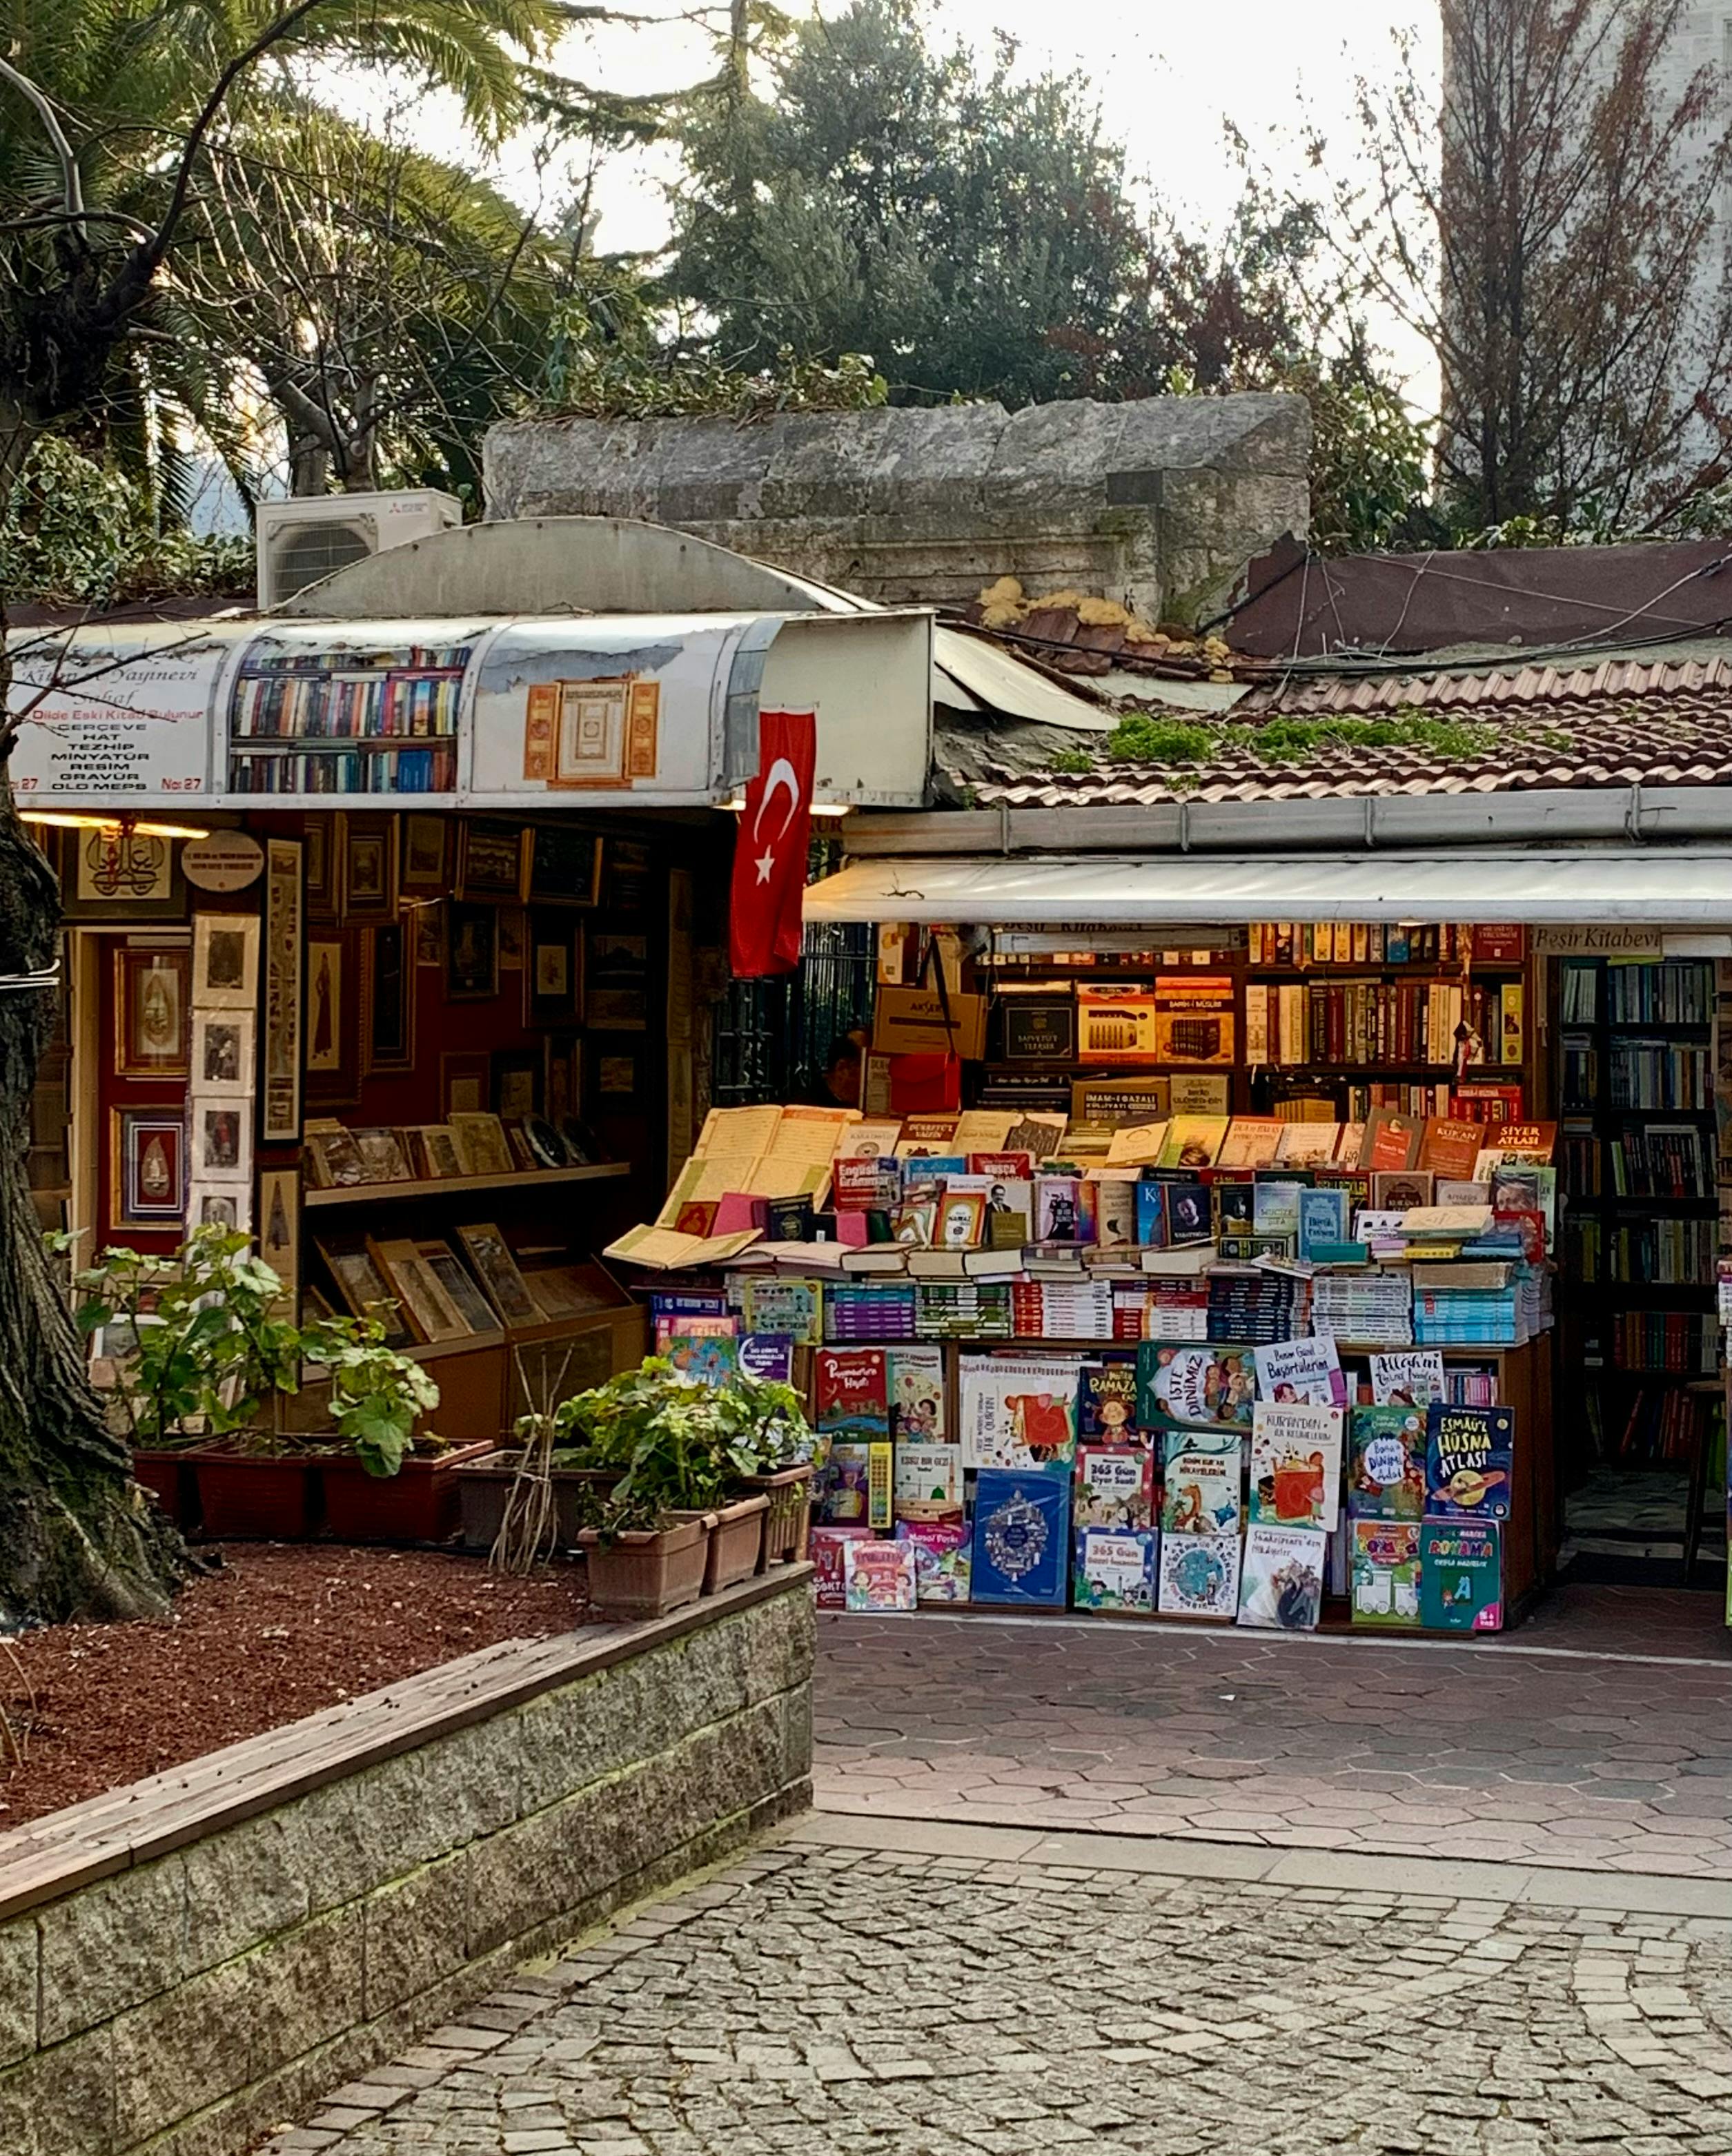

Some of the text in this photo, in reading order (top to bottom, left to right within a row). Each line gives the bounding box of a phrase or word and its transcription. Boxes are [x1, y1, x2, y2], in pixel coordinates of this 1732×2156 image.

[73, 710, 103, 720] Eski
[51, 752, 150, 761] MİNYATÜR
[70, 763, 130, 771] RESİM
[60, 772, 139, 781] GRAVÜR
[1536, 928, 1582, 949] Beşir
[1500, 1125, 1540, 1137] SİYER
[1497, 1136, 1539, 1146] ATLASI
[838, 1164, 878, 1179] English
[1089, 1377, 1138, 1393] RAMAZA
[1091, 1464, 1136, 1476] 365 Gün
[1439, 1450, 1487, 1478] ATLASI
[1092, 1545, 1139, 1558] 365 Gün
